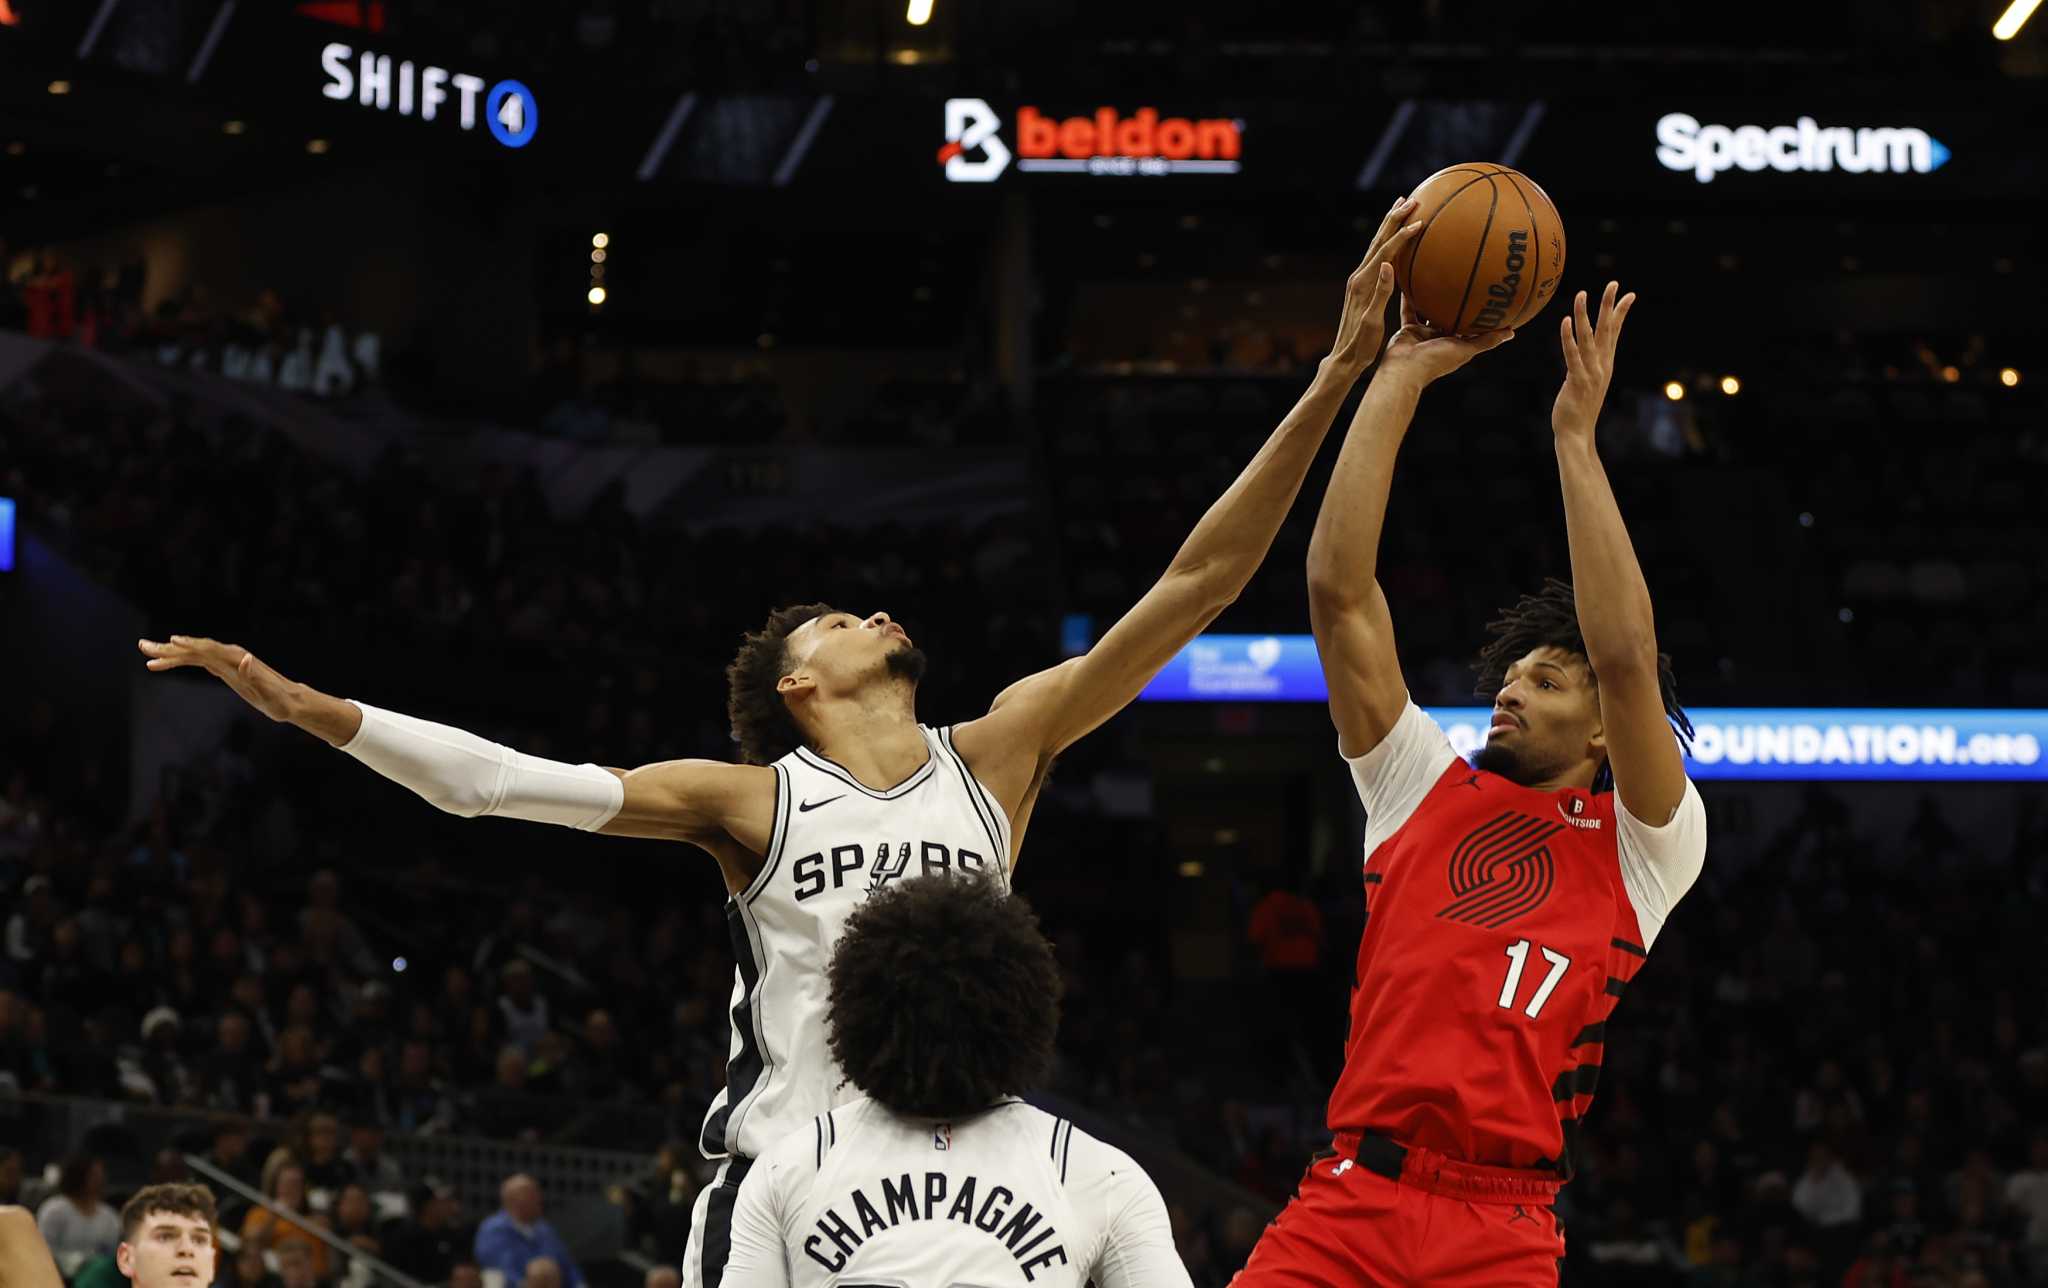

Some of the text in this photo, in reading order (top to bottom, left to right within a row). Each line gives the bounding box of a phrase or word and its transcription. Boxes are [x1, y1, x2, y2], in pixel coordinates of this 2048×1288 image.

[1017, 105, 1241, 160] beldon
[1656, 112, 1932, 183] Spectrum
[1469, 229, 1528, 330] Wilson
[793, 840, 985, 902] SPURS
[1498, 939, 1571, 1019] 17
[804, 1172, 1067, 1283] CHAMPAGNIE
